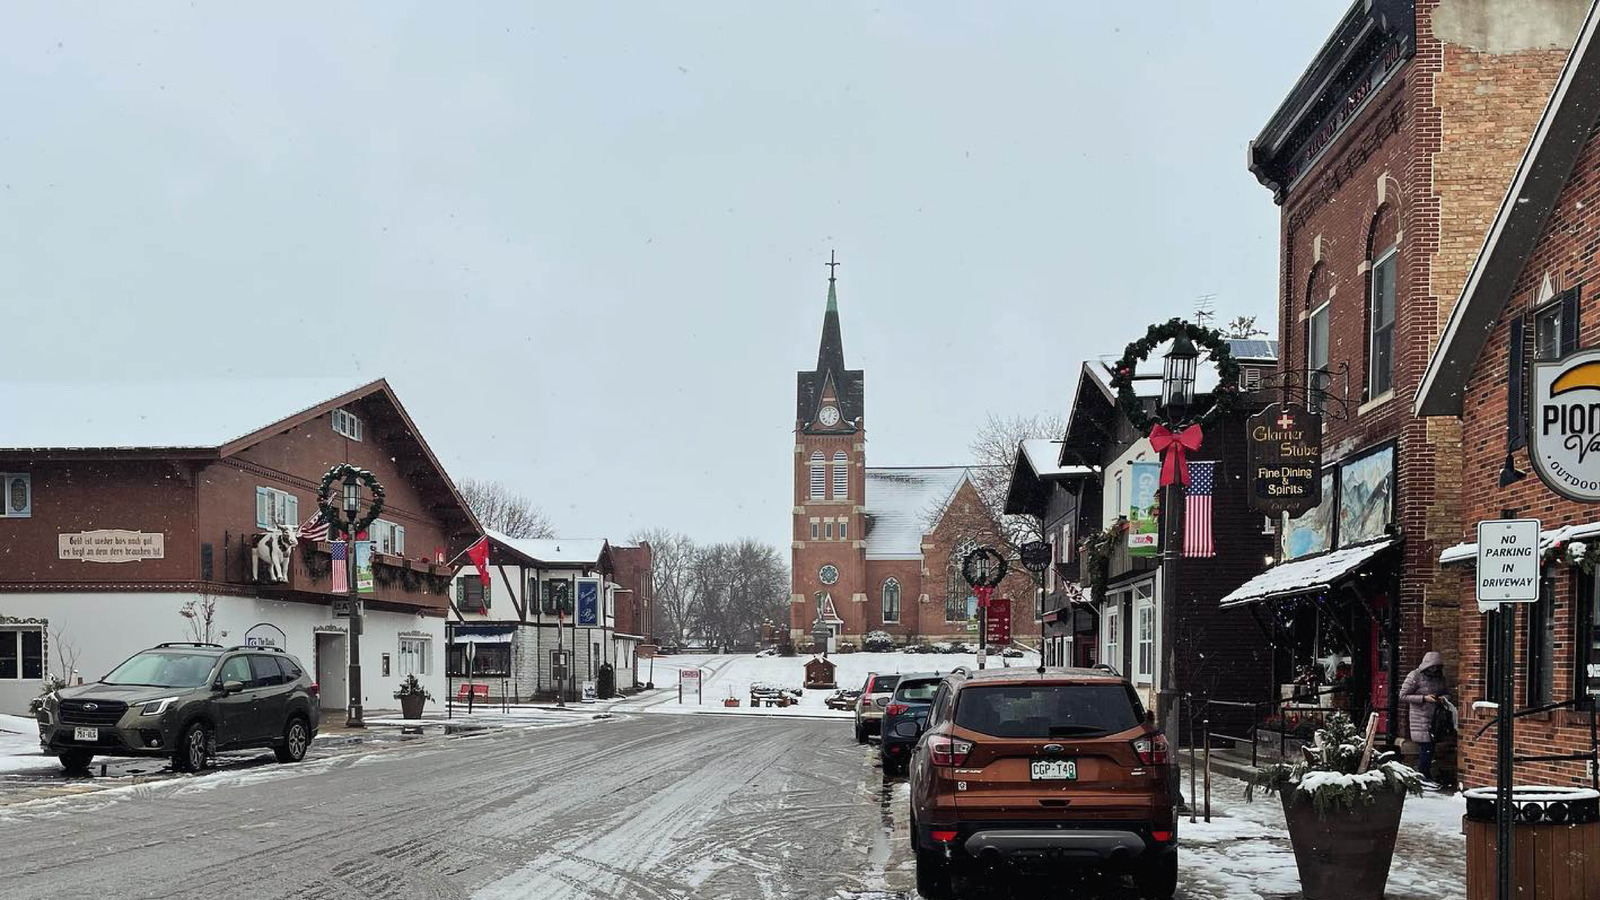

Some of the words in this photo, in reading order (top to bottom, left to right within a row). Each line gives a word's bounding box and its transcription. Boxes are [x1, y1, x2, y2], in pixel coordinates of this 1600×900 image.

[1252, 425, 1304, 441] Glarner
[1280, 442, 1318, 457] Stube
[1258, 468, 1280, 478] Fine
[1281, 467, 1312, 479] Dining
[1550, 461, 1600, 490] OUTDOO
[1268, 484, 1303, 496] Spirits
[1501, 535, 1517, 544] NO
[1485, 547, 1532, 557] PARKING
[1501, 563, 1514, 573] IN
[1482, 577, 1534, 587] DRIVEWAY
